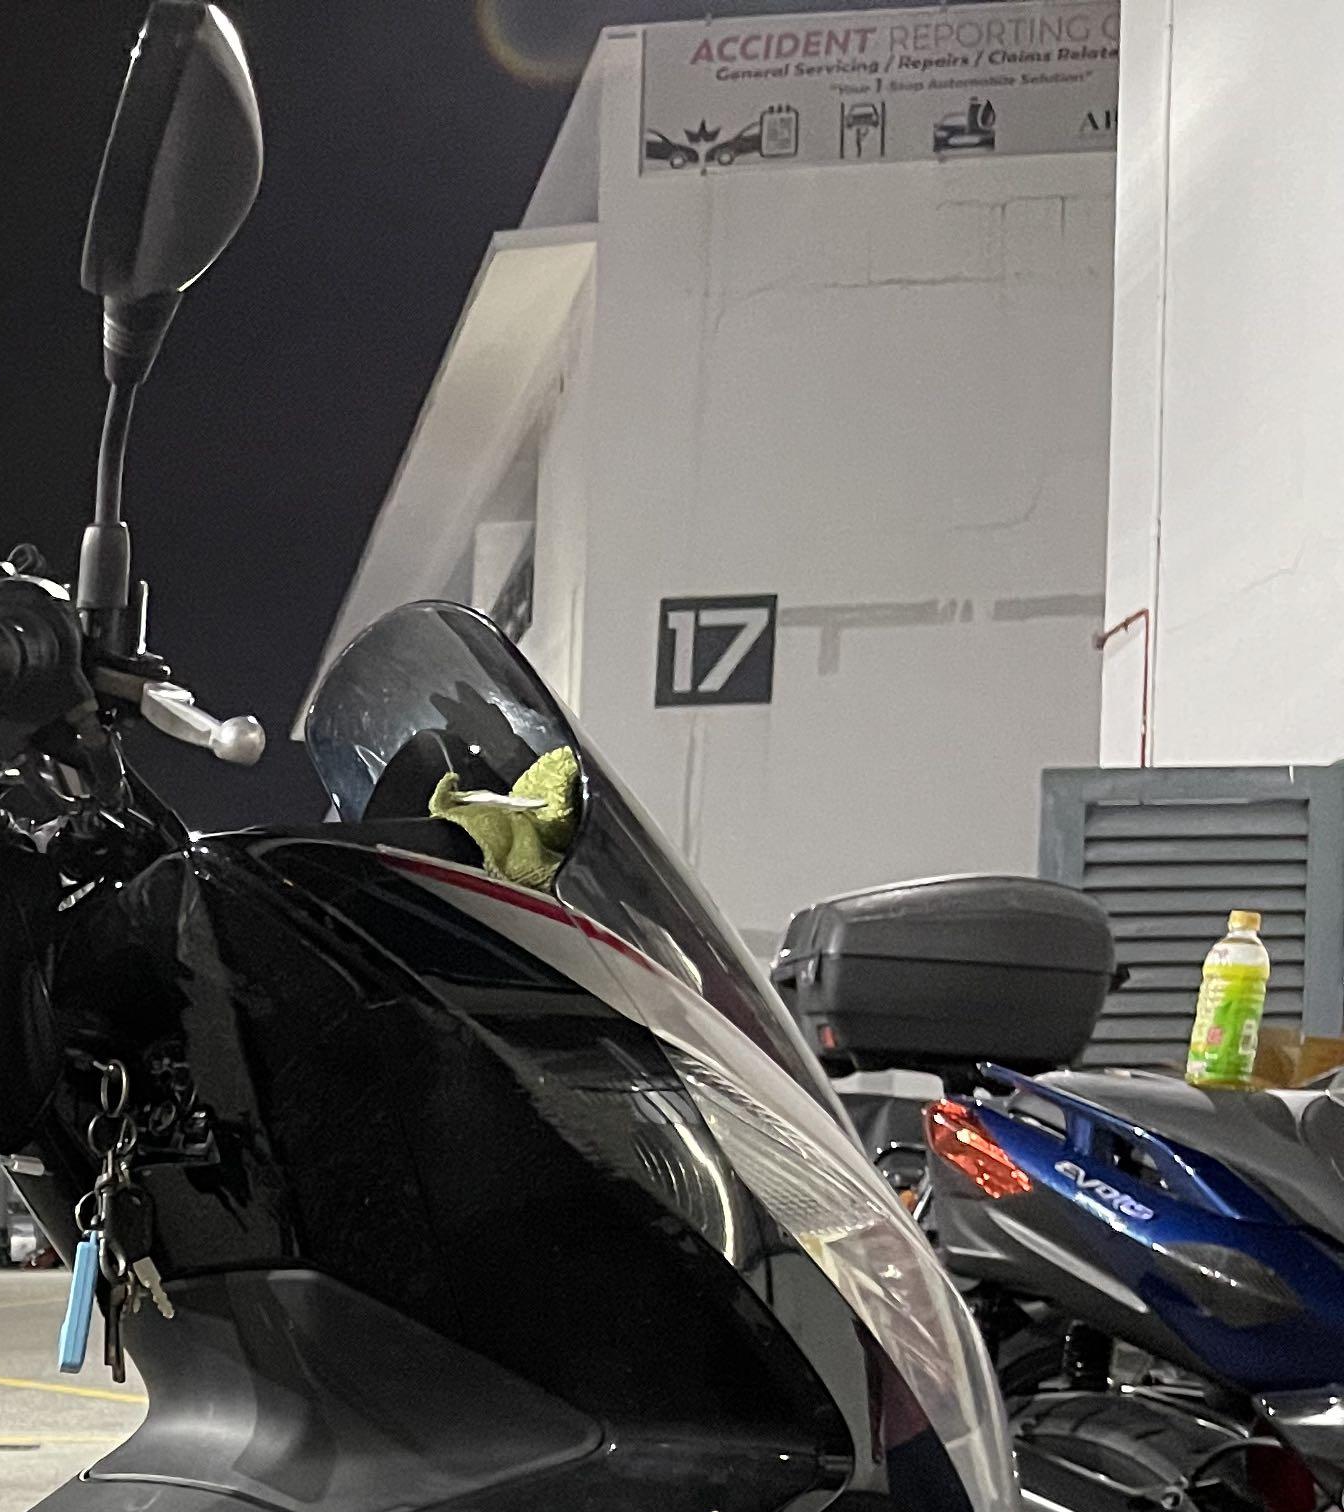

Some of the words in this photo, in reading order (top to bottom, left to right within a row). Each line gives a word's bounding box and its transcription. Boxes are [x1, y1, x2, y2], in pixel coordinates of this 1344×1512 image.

[689, 26, 878, 64] ACCIDENT
[889, 15, 1090, 51] REPORTING
[715, 63, 789, 82] General
[793, 58, 880, 75] Servicing
[897, 52, 970, 72] Repairs
[987, 47, 1051, 65] Claims
[667, 608, 770, 694] 17
